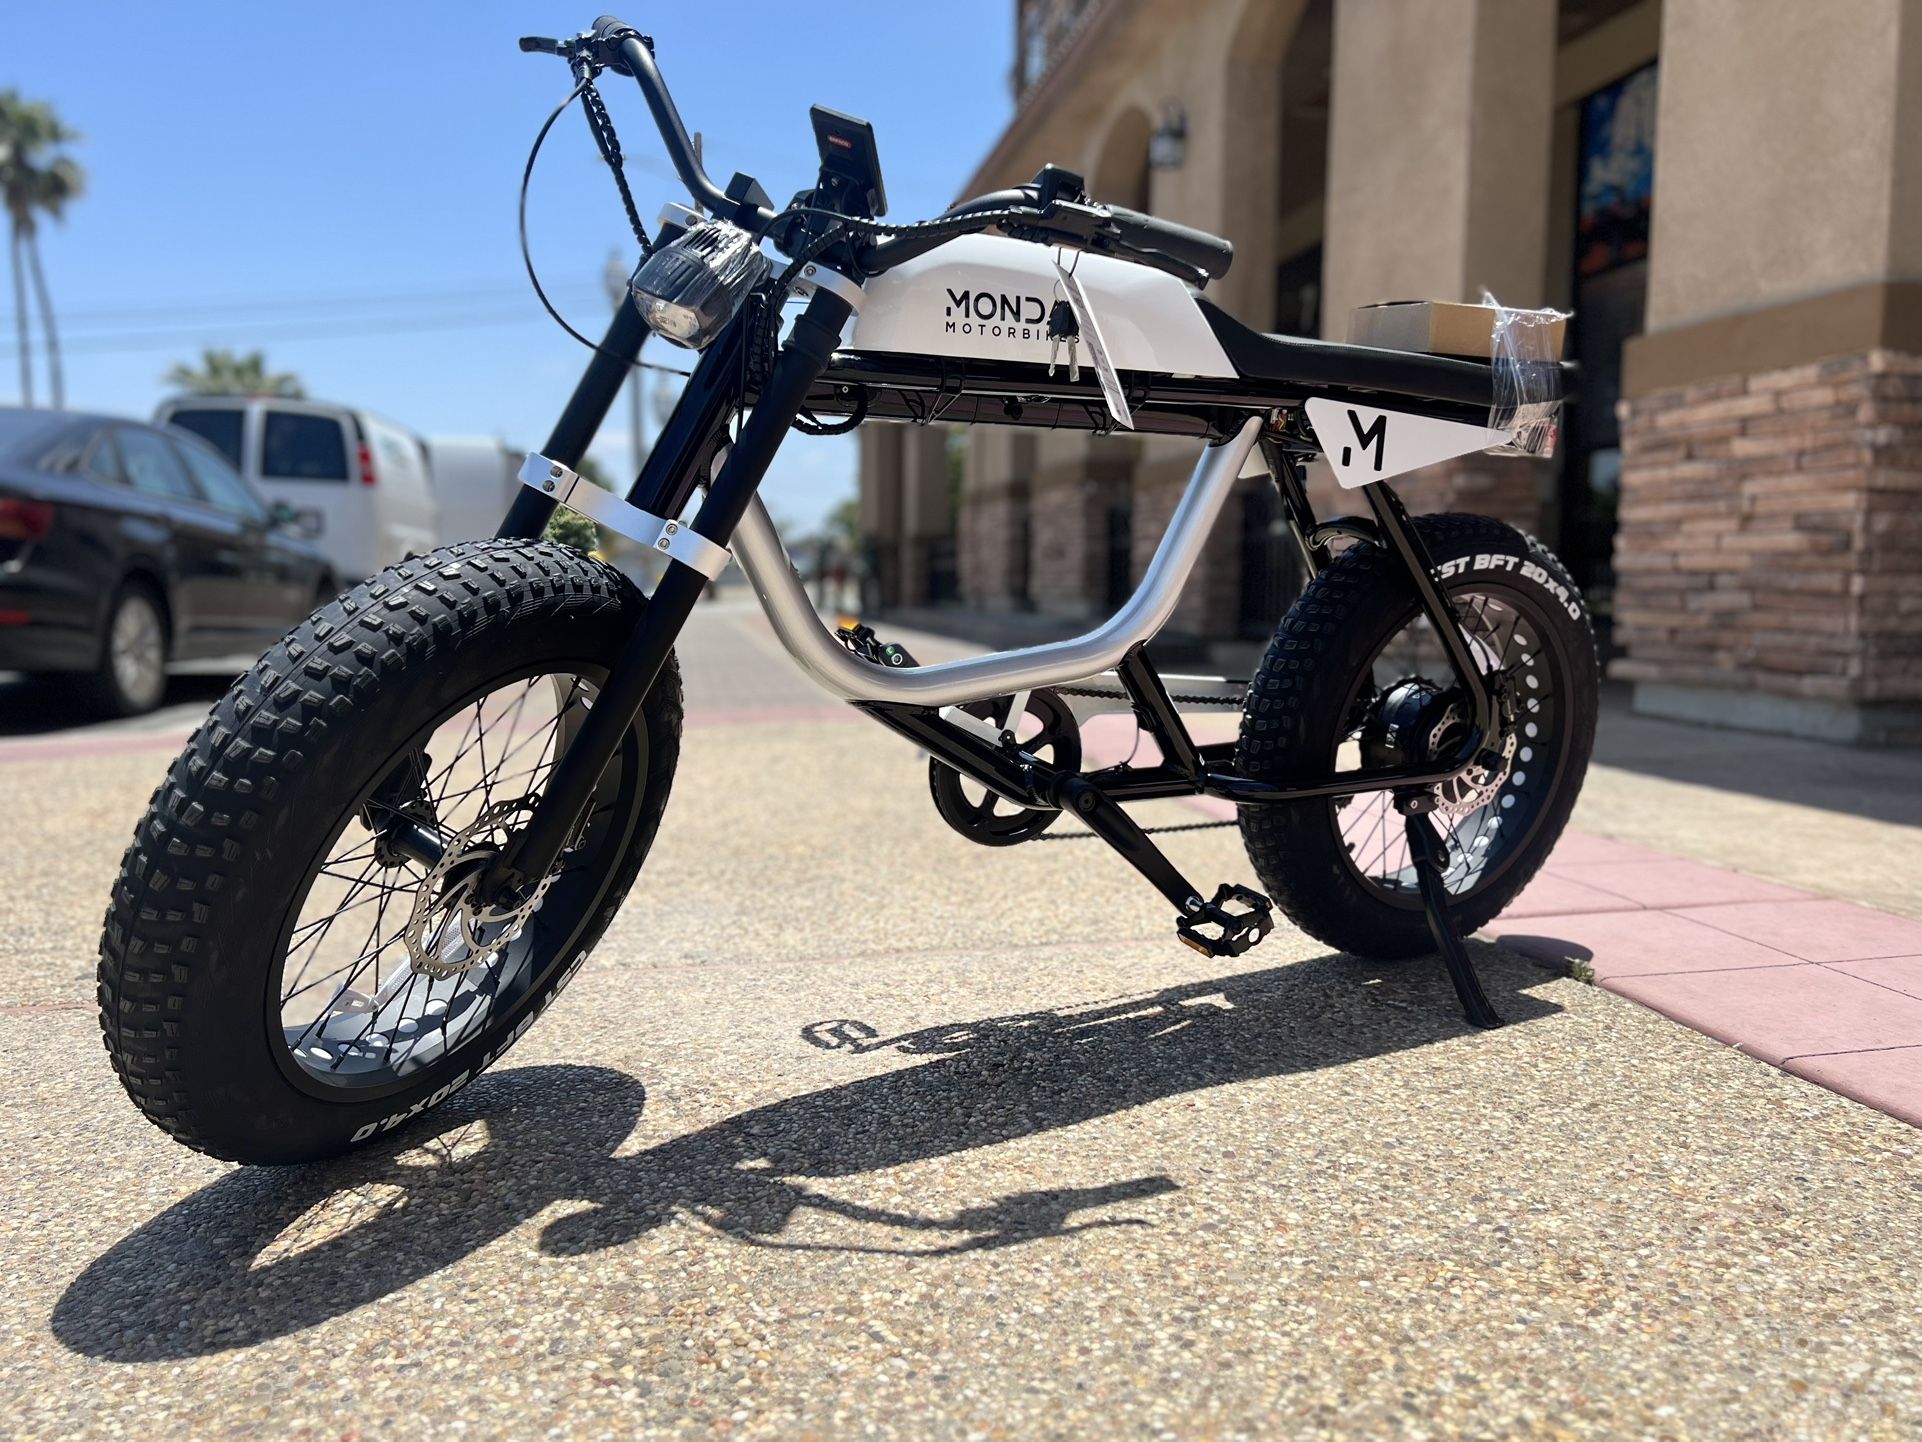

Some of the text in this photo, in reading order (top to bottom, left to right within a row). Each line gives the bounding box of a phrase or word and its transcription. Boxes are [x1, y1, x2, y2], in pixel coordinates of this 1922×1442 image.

[946, 288, 1060, 325] MOND
[945, 322, 1080, 343] MOTORBIKS
[1341, 409, 1387, 472] M
[1473, 553, 1520, 572] BFT
[537, 950, 587, 1015] CST
[476, 1011, 534, 1074] BFT
